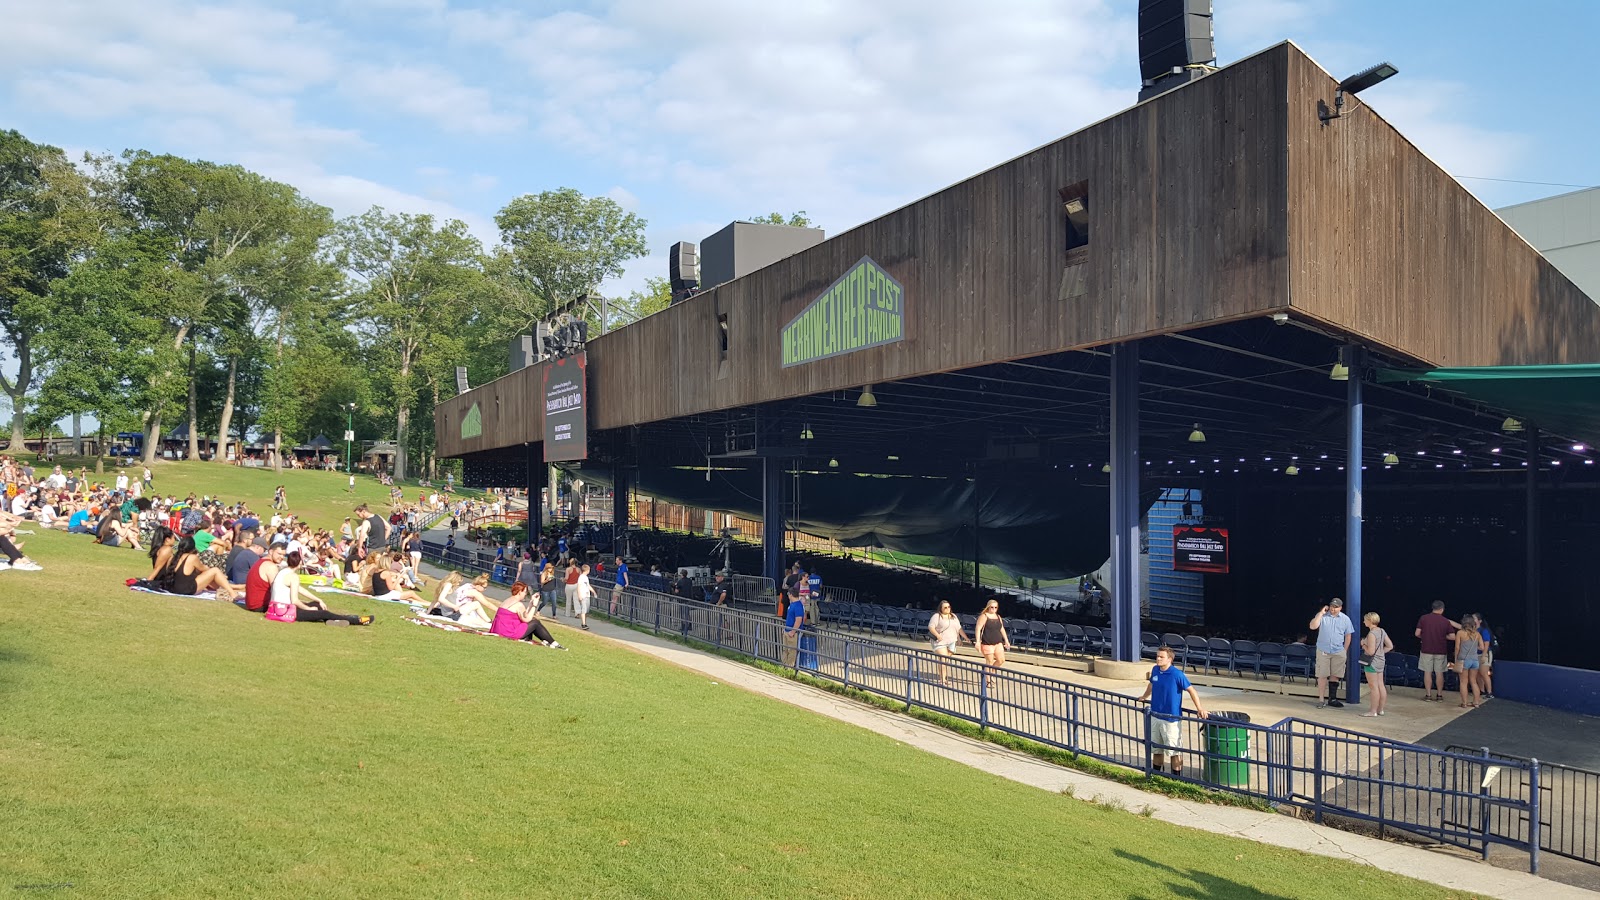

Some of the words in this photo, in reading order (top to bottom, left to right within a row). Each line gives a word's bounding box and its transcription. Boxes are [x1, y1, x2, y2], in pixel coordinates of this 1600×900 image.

[867, 262, 901, 313] POST
[783, 263, 866, 365] MERRIWEATHER
[867, 308, 901, 345] PAVILION
